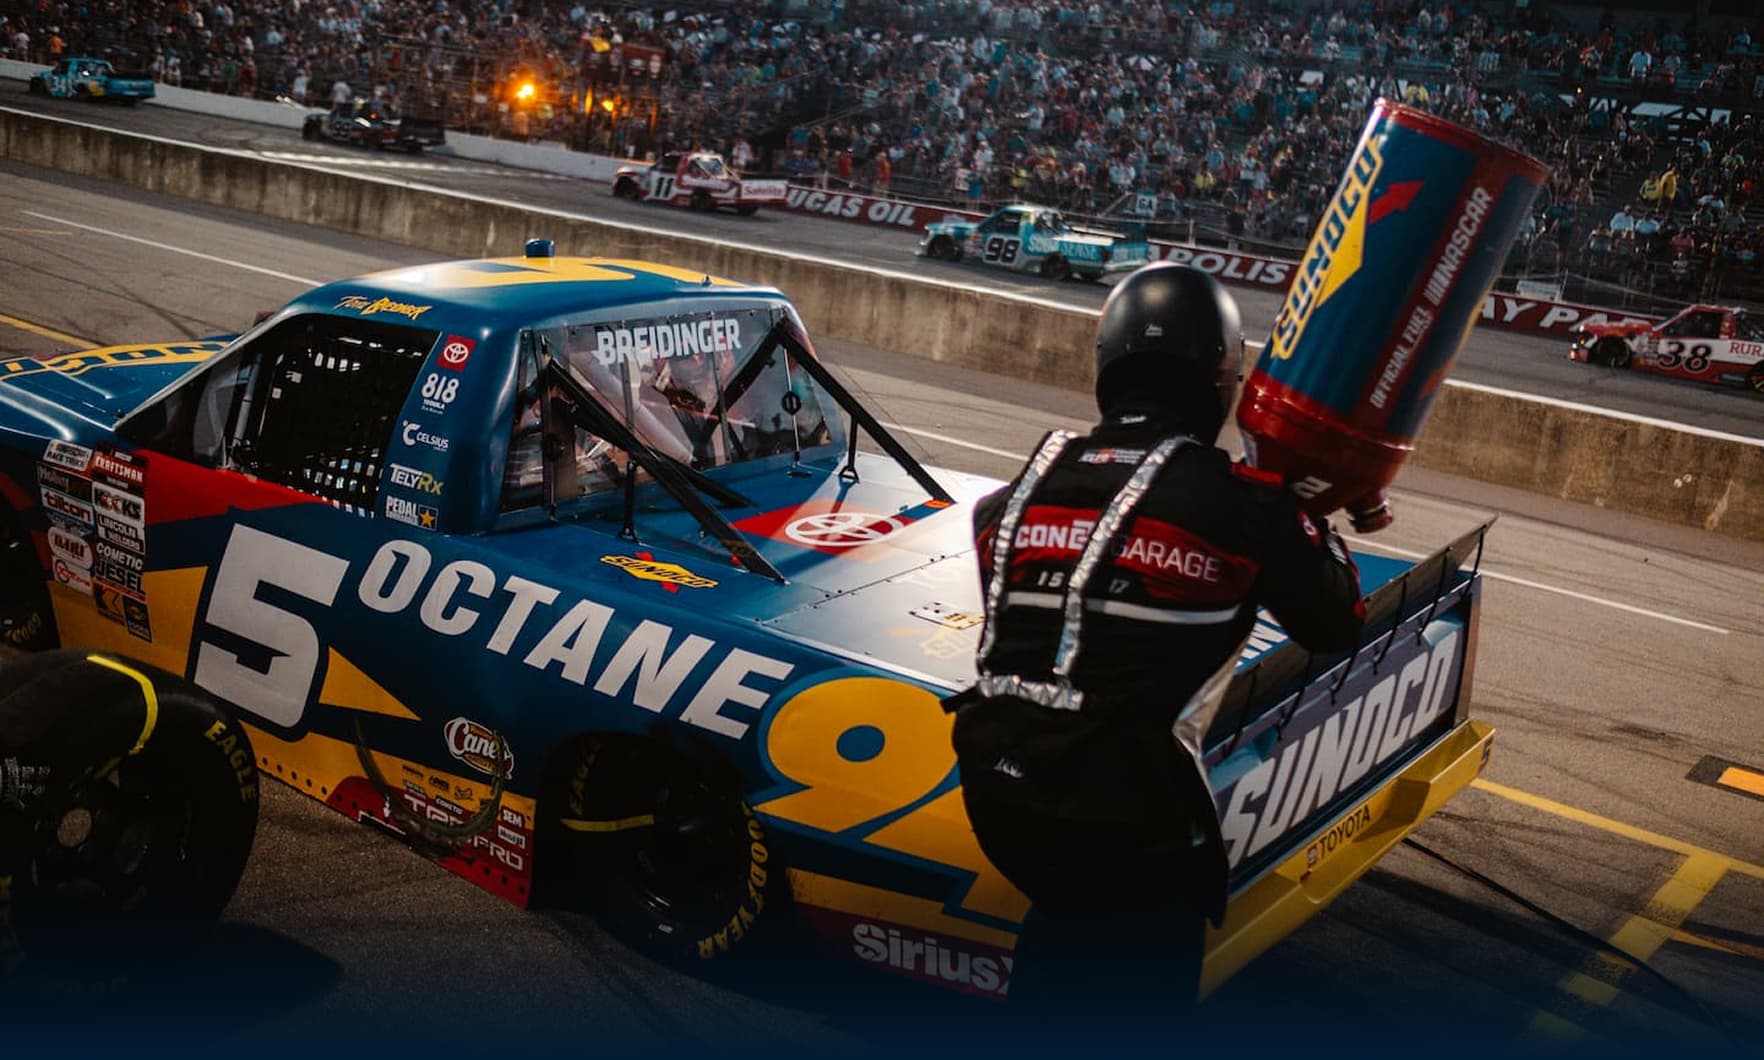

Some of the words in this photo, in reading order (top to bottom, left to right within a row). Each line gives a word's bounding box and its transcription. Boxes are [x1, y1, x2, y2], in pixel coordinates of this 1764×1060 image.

[655, 177, 674, 198] 11
[868, 202, 915, 226] OIL
[984, 237, 1021, 263] 98
[1274, 135, 1385, 358] SUNOCO
[1369, 344, 1410, 409] OFFICIAL
[1402, 305, 1430, 344] FUEL
[1437, 186, 1494, 287] NASCAR
[596, 318, 742, 366] BREIDINGER
[1657, 341, 1713, 373] 38
[421, 372, 460, 404] 818
[416, 431, 449, 449] CELSIUS
[95, 455, 143, 483] CRAFTSMAN
[386, 495, 419, 518] PEDAL
[96, 541, 144, 571] COMETIC
[96, 559, 144, 594] JESEL
[1037, 570, 1065, 588] 15
[1108, 578, 1131, 595] 17
[193, 524, 351, 728] 5
[357, 540, 793, 739] OCTANE
[202, 719, 256, 804] EAGLE
[1221, 630, 1458, 870] SUNOCO
[1318, 804, 1373, 860] TOYOTA
